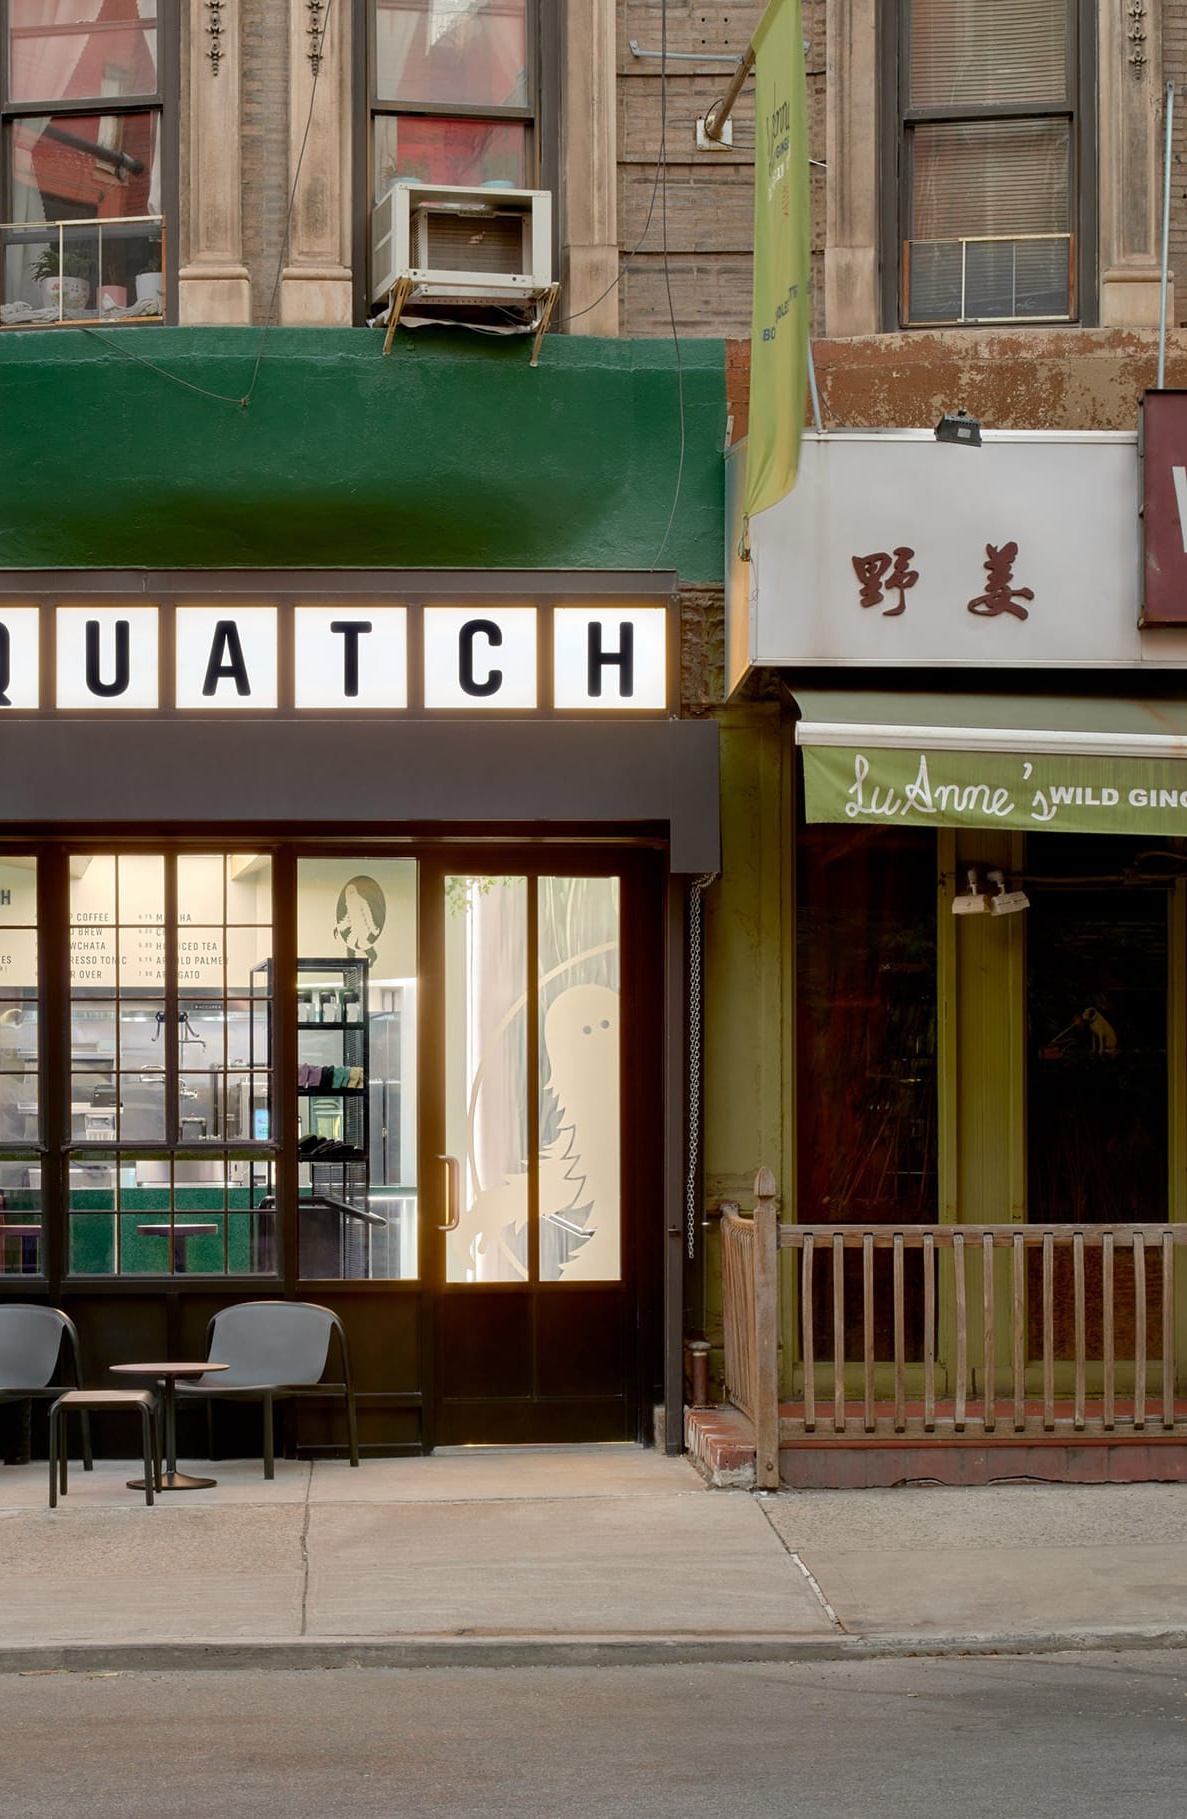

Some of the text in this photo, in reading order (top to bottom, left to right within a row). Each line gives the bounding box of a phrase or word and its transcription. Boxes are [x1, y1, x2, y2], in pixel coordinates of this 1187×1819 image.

[1050, 786, 1119, 805] WILD
[76, 912, 110, 922] COFFEE
[78, 927, 103, 937] BREW
[201, 942, 218, 951] TEA
[100, 955, 128, 965] TONC
[194, 956, 229, 965] PALME
[79, 969, 102, 980] OVER
